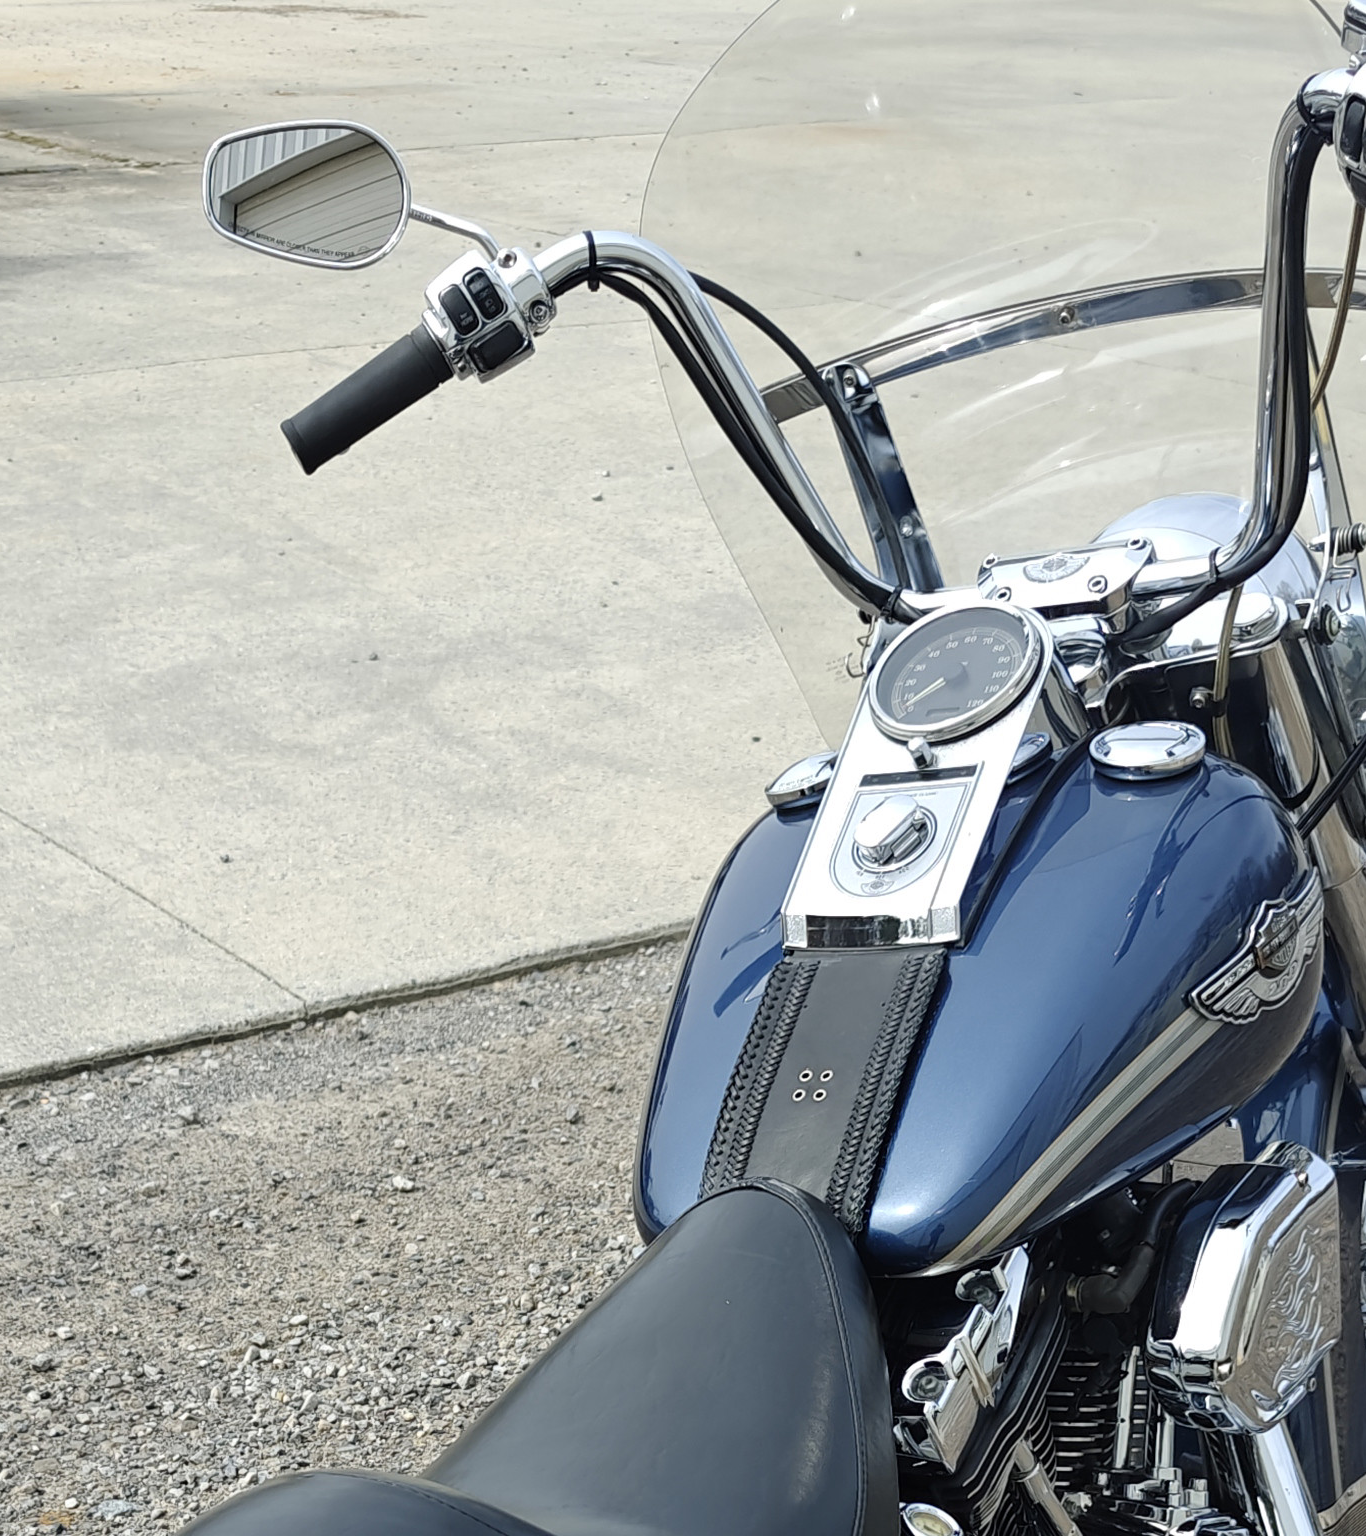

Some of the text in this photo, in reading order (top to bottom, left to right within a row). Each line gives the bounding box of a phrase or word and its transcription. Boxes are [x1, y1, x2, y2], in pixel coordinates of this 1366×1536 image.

[256, 233, 275, 243] MIRROR
[276, 239, 286, 247] ARE
[321, 248, 333, 257] THEY
[964, 635, 977, 643] 60
[982, 637, 993, 645] 70
[946, 641, 958, 649] 50
[992, 644, 1005, 652] 80
[928, 650, 940, 658] 40
[914, 664, 926, 672] 30
[992, 670, 1008, 679] 100
[984, 685, 999, 693] 110
[967, 699, 983, 708] 120
